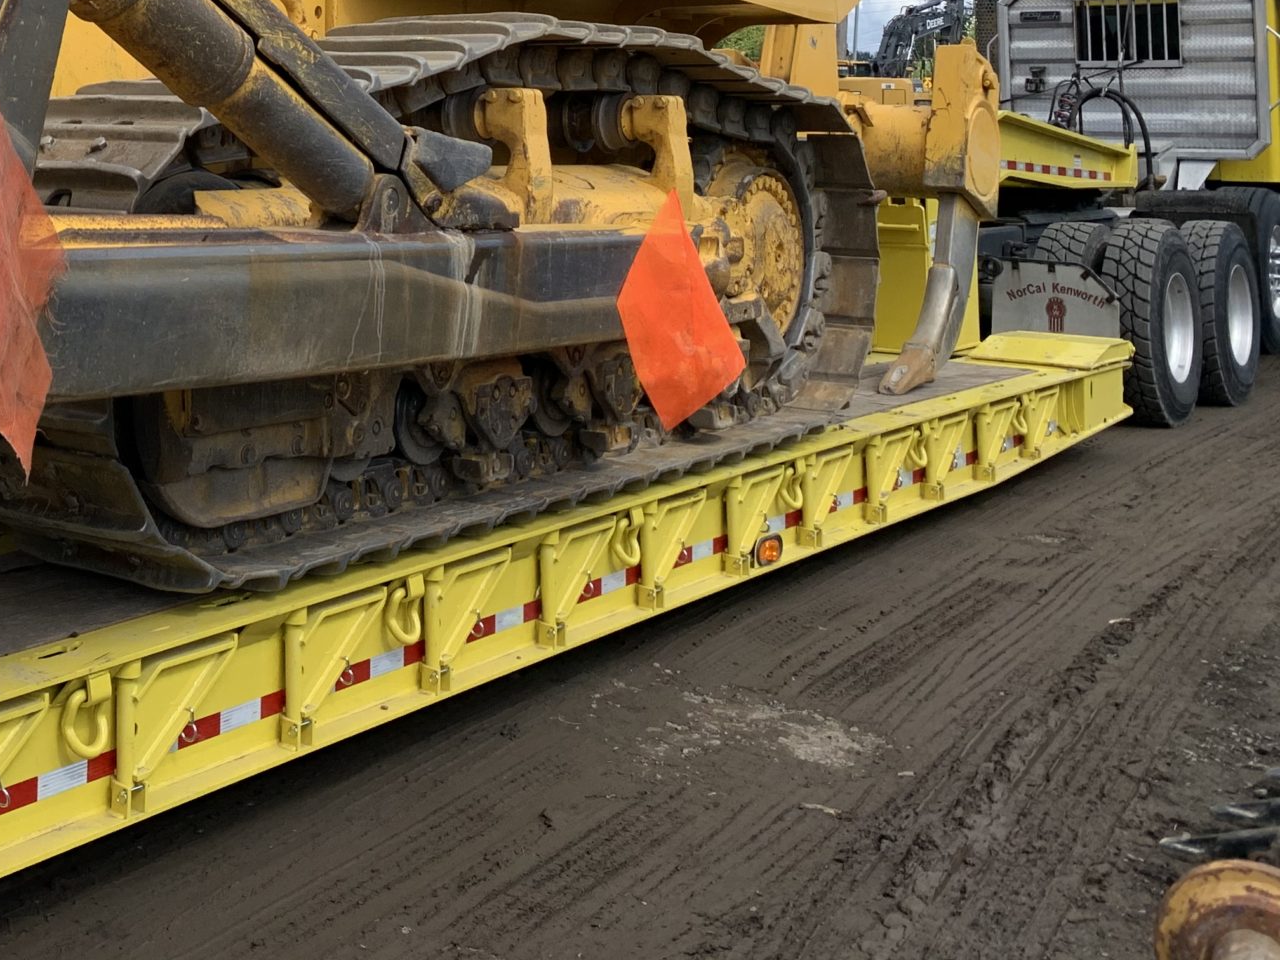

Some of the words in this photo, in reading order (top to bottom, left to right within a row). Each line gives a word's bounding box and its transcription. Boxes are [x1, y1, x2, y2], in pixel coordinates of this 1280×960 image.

[926, 16, 945, 30] DEERE
[1006, 282, 1046, 301] NorCal
[1051, 282, 1106, 309] Kenworth
